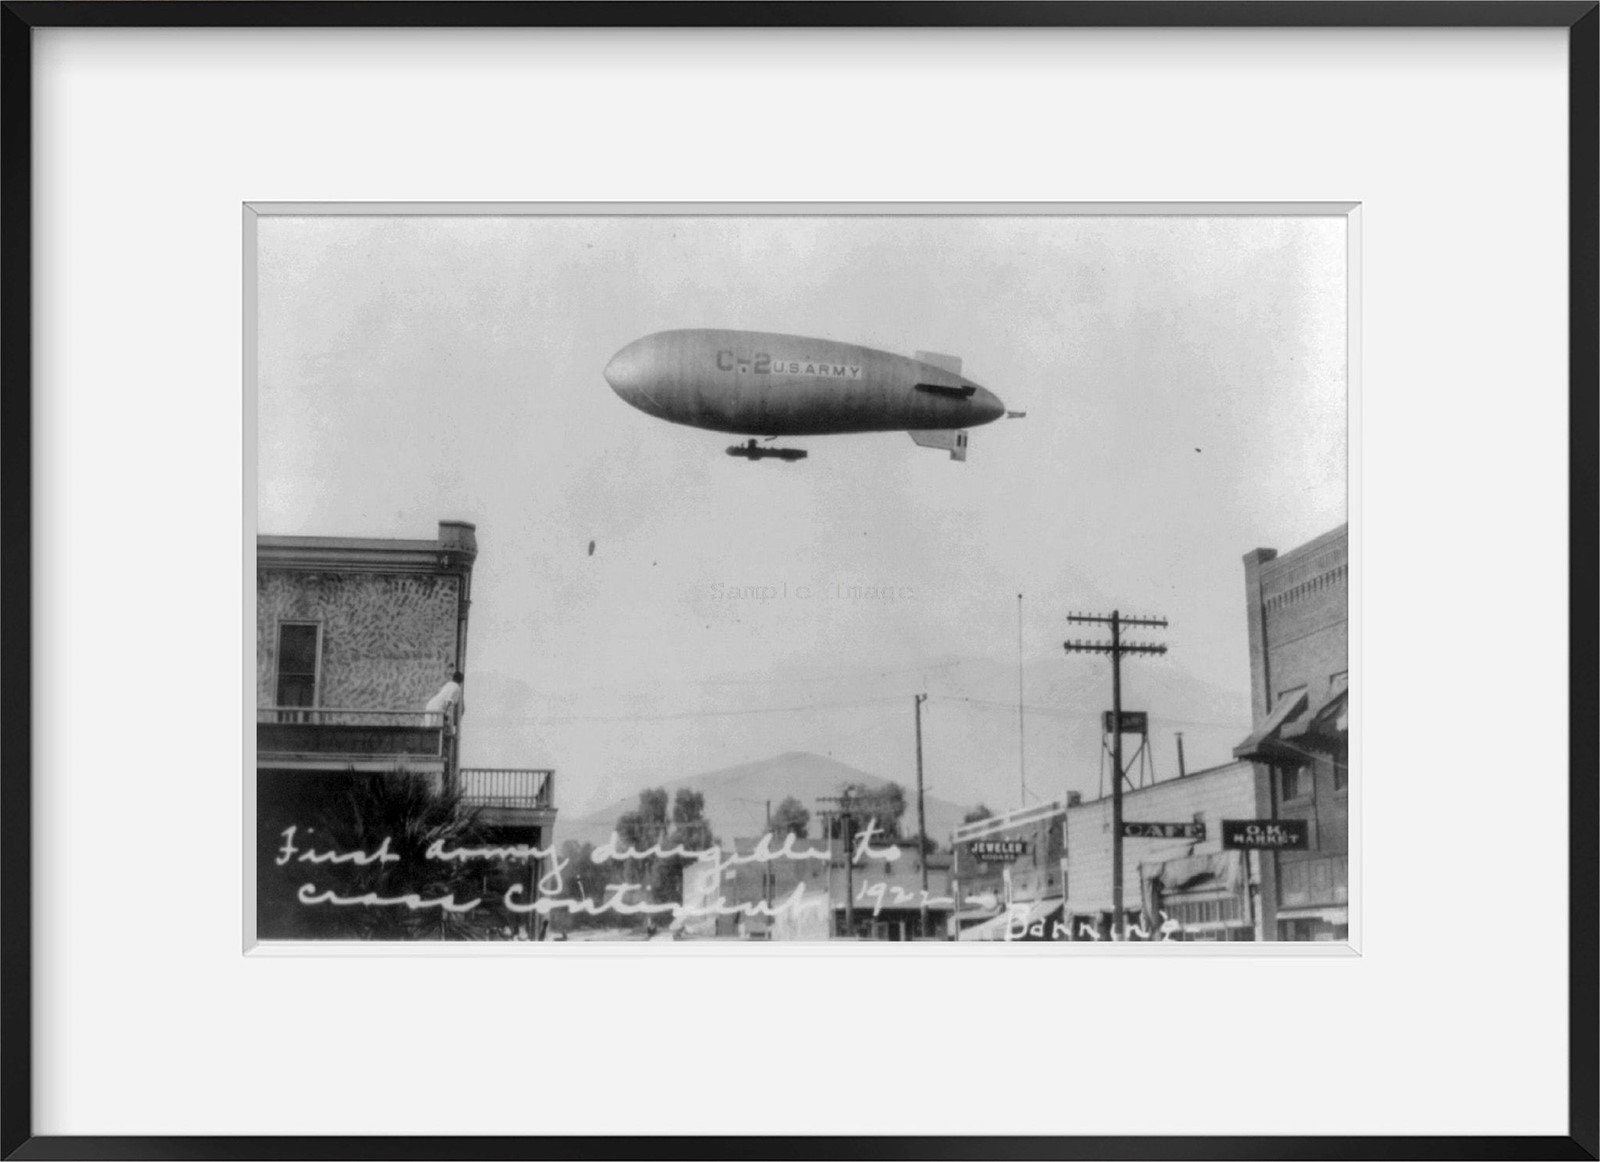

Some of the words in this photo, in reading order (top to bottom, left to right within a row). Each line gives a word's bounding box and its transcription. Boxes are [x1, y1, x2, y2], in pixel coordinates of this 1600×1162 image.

[1123, 824, 1206, 838] CAFE
[1232, 834, 1299, 845] MARKET
[971, 842, 1022, 853] JEWELER
